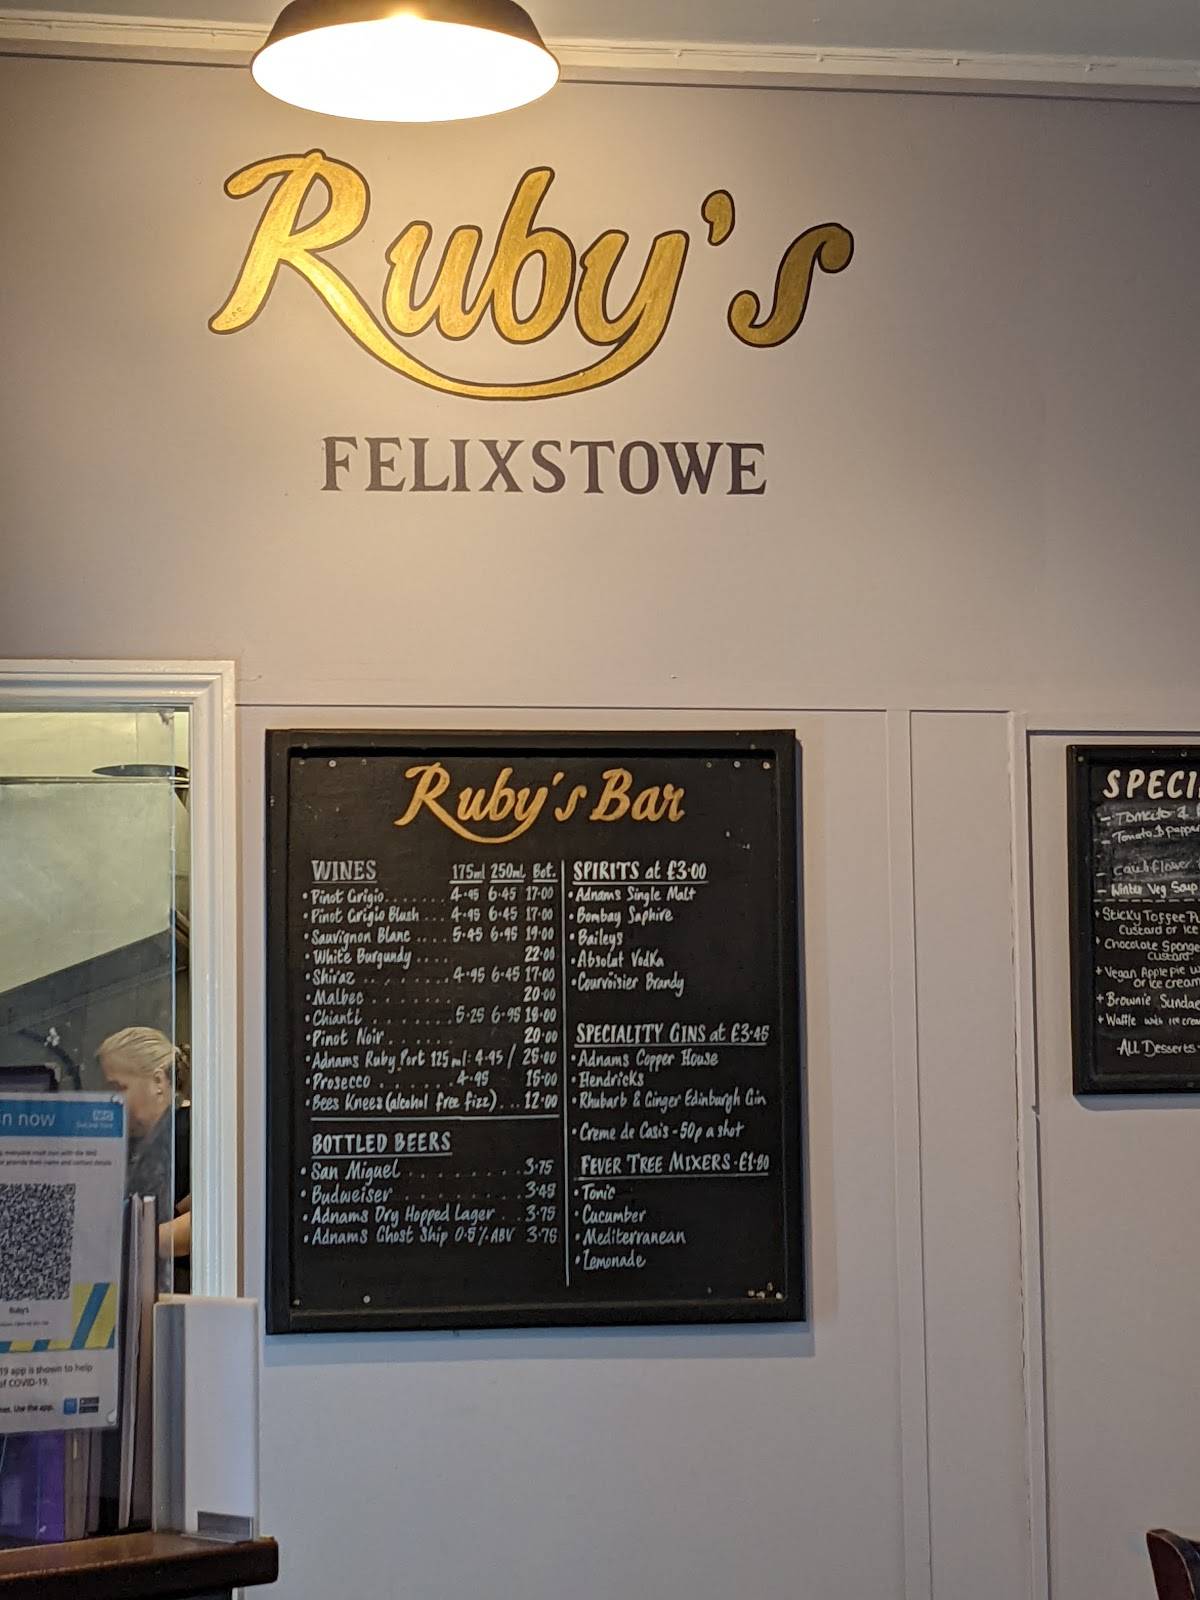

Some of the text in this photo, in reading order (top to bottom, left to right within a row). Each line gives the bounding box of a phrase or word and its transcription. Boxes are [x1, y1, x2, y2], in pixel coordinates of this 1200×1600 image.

[208, 148, 854, 401] Ruby's
[319, 436, 767, 495] FELIXSTOWE
[394, 762, 685, 843] Ruby's Bar
[1112, 827, 1152, 843] Tomato
[311, 860, 376, 881] WINES
[574, 861, 640, 881] SPIRITS
[645, 865, 661, 879] at
[311, 889, 343, 904] Pinot
[347, 888, 384, 907] Grigio
[575, 886, 696, 907] Adnams Single Malt
[1147, 883, 1167, 899] Veg
[1171, 880, 1198, 894] Soup
[311, 908, 343, 924] Pinot
[348, 907, 385, 927] Grigio
[388, 906, 419, 922] Blush
[577, 906, 674, 928] Bombay Saphire
[1102, 907, 1185, 926] Sticky Toffee
[311, 928, 371, 950] Sauvignon
[378, 926, 411, 943] Blanc
[578, 929, 623, 951] Baileys
[1166, 925, 1177, 935] or
[1104, 938, 1158, 950] Chocolate
[313, 948, 352, 964] White
[357, 946, 411, 969] Burgundy
[577, 950, 624, 968] Absolut
[313, 968, 355, 985] Shiraz
[646, 970, 684, 997] Brandy
[1104, 967, 1137, 983] Vegan
[1141, 966, 1168, 978] Apple
[313, 989, 364, 1006] Malbec
[1106, 992, 1151, 1007] Brownie
[313, 1008, 362, 1026] Chianti
[1106, 1013, 1136, 1026] Waffle
[313, 1029, 348, 1047] Pinot
[357, 1028, 384, 1045] Noir
[576, 1023, 664, 1044] SPECIALITY
[669, 1023, 706, 1043] GINS
[710, 1024, 726, 1042] at
[1141, 1039, 1196, 1057] Desserts
[312, 1052, 359, 1070] Adnams
[365, 1051, 395, 1073] Ruby
[400, 1049, 425, 1067] Port
[577, 1049, 719, 1072] Adnams Copper House
[313, 1073, 371, 1090] Prosecco
[312, 1094, 339, 1111] Bees
[345, 1094, 383, 1111] Knees
[386, 1090, 428, 1112] (alcohol
[436, 1093, 460, 1112] free
[465, 1089, 497, 1112] fizz)
[580, 1087, 766, 1114] Rhubarb & Ginger Edinburgh Gin
[18, 1113, 56, 1127] now
[580, 1119, 744, 1143] Creme de Casis 50p a shot
[312, 1131, 451, 1154] BOTTLED BEERS
[311, 1161, 338, 1181] San
[345, 1159, 400, 1185] Miguel
[581, 1155, 622, 1175] FEVER
[627, 1153, 663, 1174] TREE
[669, 1151, 730, 1172] MIXERS
[312, 1185, 393, 1205] Budweiser
[582, 1183, 616, 1201] Tonic
[311, 1206, 368, 1224] Adnams
[375, 1206, 399, 1228] Dry
[405, 1203, 449, 1227] Hopped
[455, 1204, 495, 1226] Lager
[582, 1204, 646, 1225] Cucumber
[312, 1227, 368, 1245] Adnams
[376, 1225, 414, 1243] Ghost
[420, 1226, 448, 1247] Ship
[583, 1227, 686, 1246] Mediterranean
[583, 1249, 646, 1271] Lemonade
